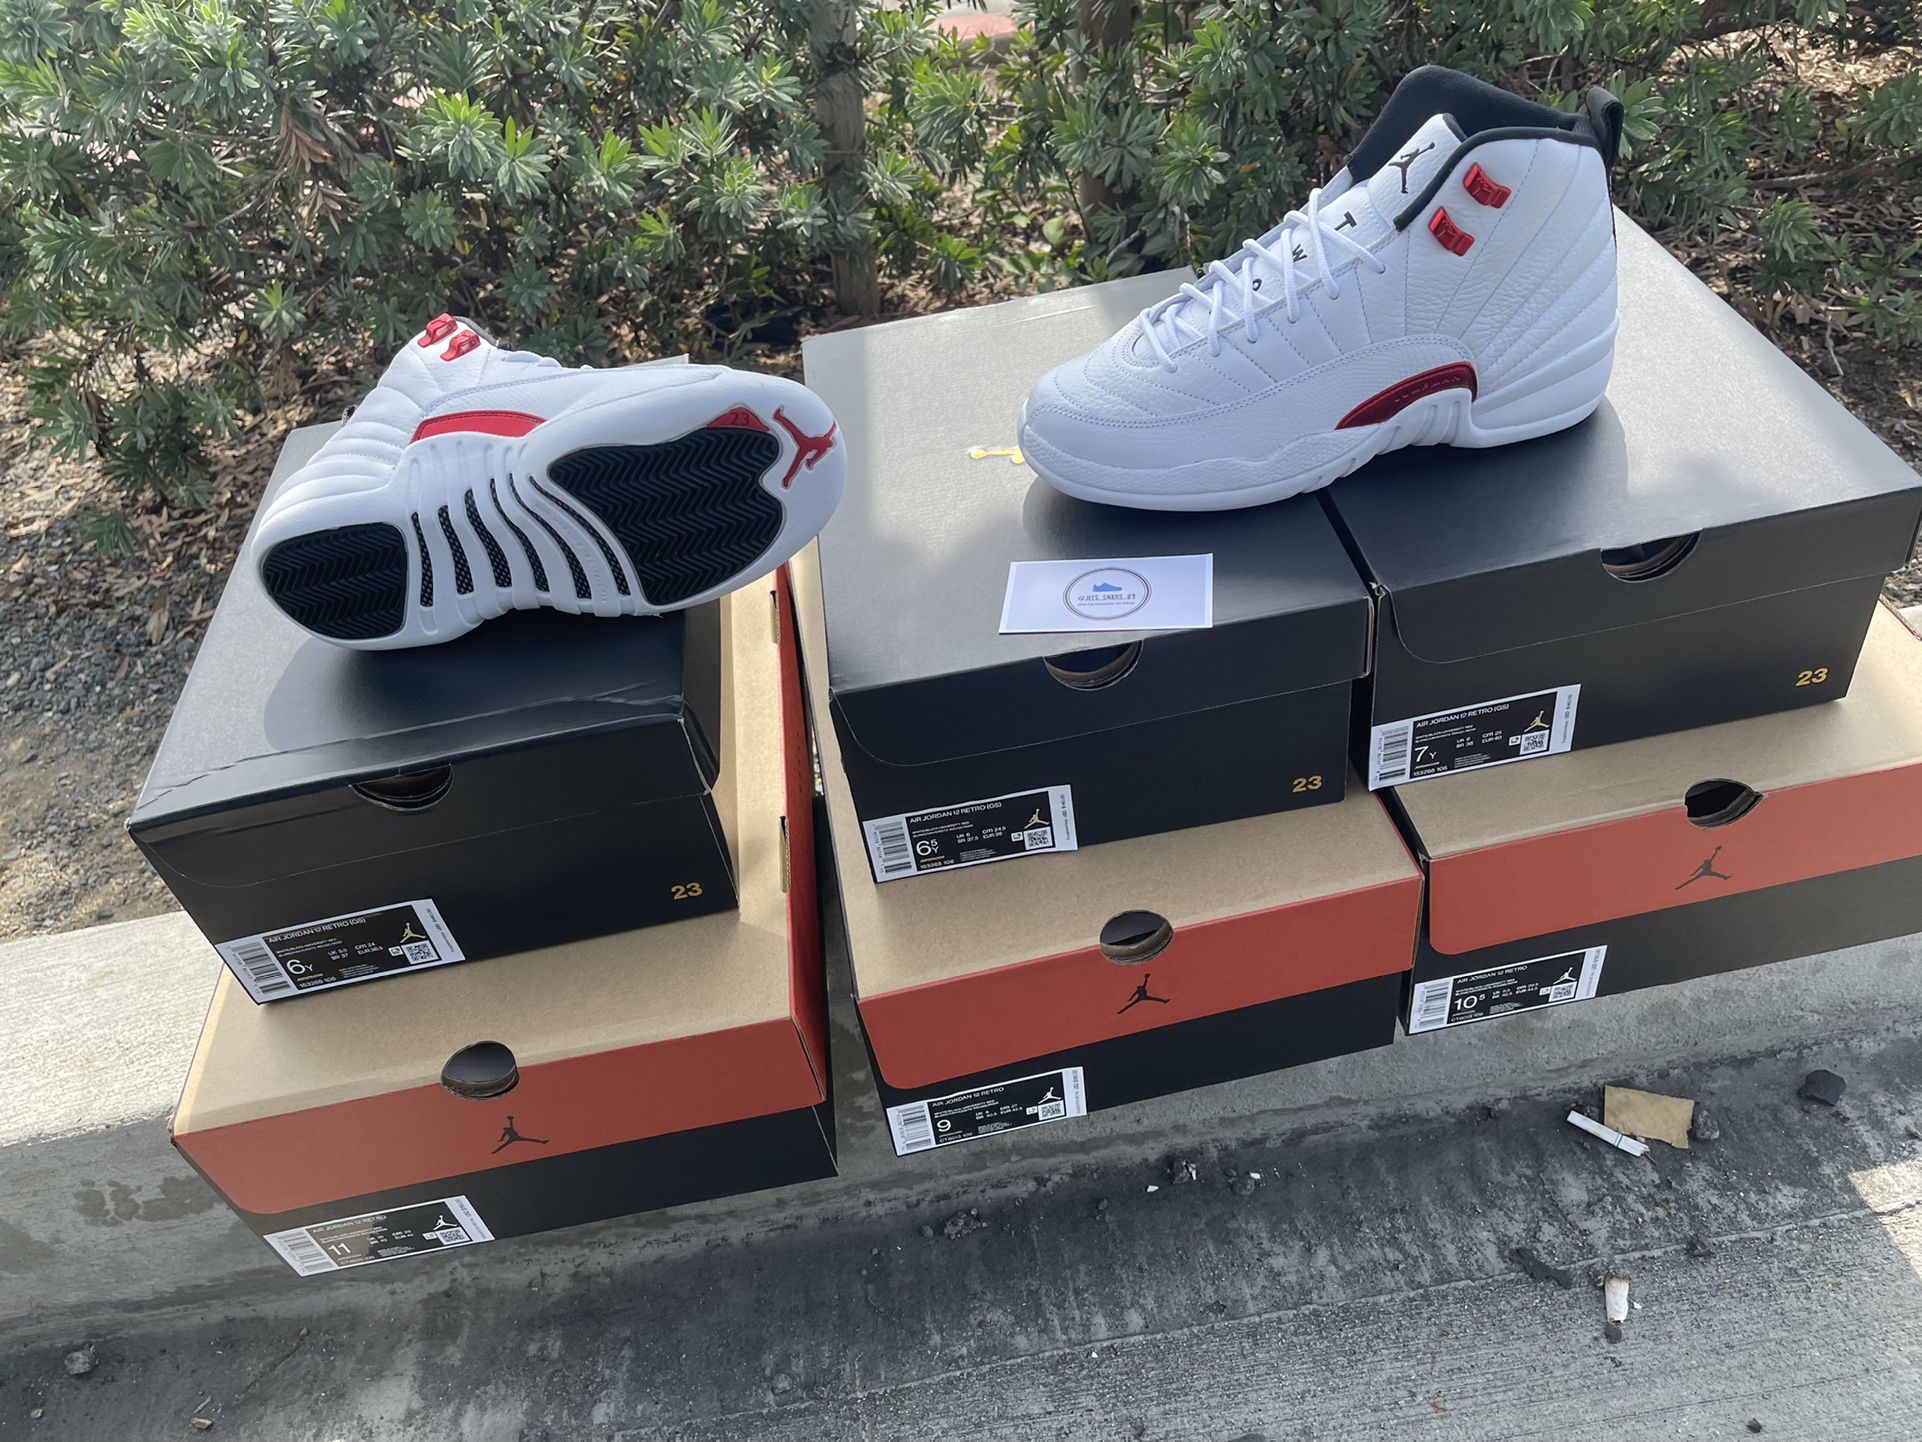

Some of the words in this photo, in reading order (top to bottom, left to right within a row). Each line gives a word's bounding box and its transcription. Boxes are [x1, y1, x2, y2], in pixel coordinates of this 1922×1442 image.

[729, 411, 750, 427] 23
[1795, 667, 1829, 687] 23
[1429, 714, 1460, 726] JORDAN
[1468, 706, 1494, 718] RETRO
[1414, 745, 1429, 763] 7
[1292, 774, 1323, 793] 23
[909, 816, 922, 824] AIR
[922, 810, 952, 822] JORDAN
[952, 809, 960, 817] 12
[960, 804, 986, 815] RETRO
[986, 801, 1002, 811] (GS)
[670, 882, 704, 901] 23
[268, 934, 282, 944] AIR
[282, 927, 315, 942] JORDAN
[322, 920, 350, 932] RETRO
[1469, 971, 1497, 982] JORDAN
[1504, 965, 1528, 974] RETRO
[944, 1095, 972, 1105] JORDAN
[981, 1086, 1005, 1096] RETRO
[936, 1119, 951, 1132] 9
[328, 1242, 351, 1256] 11
